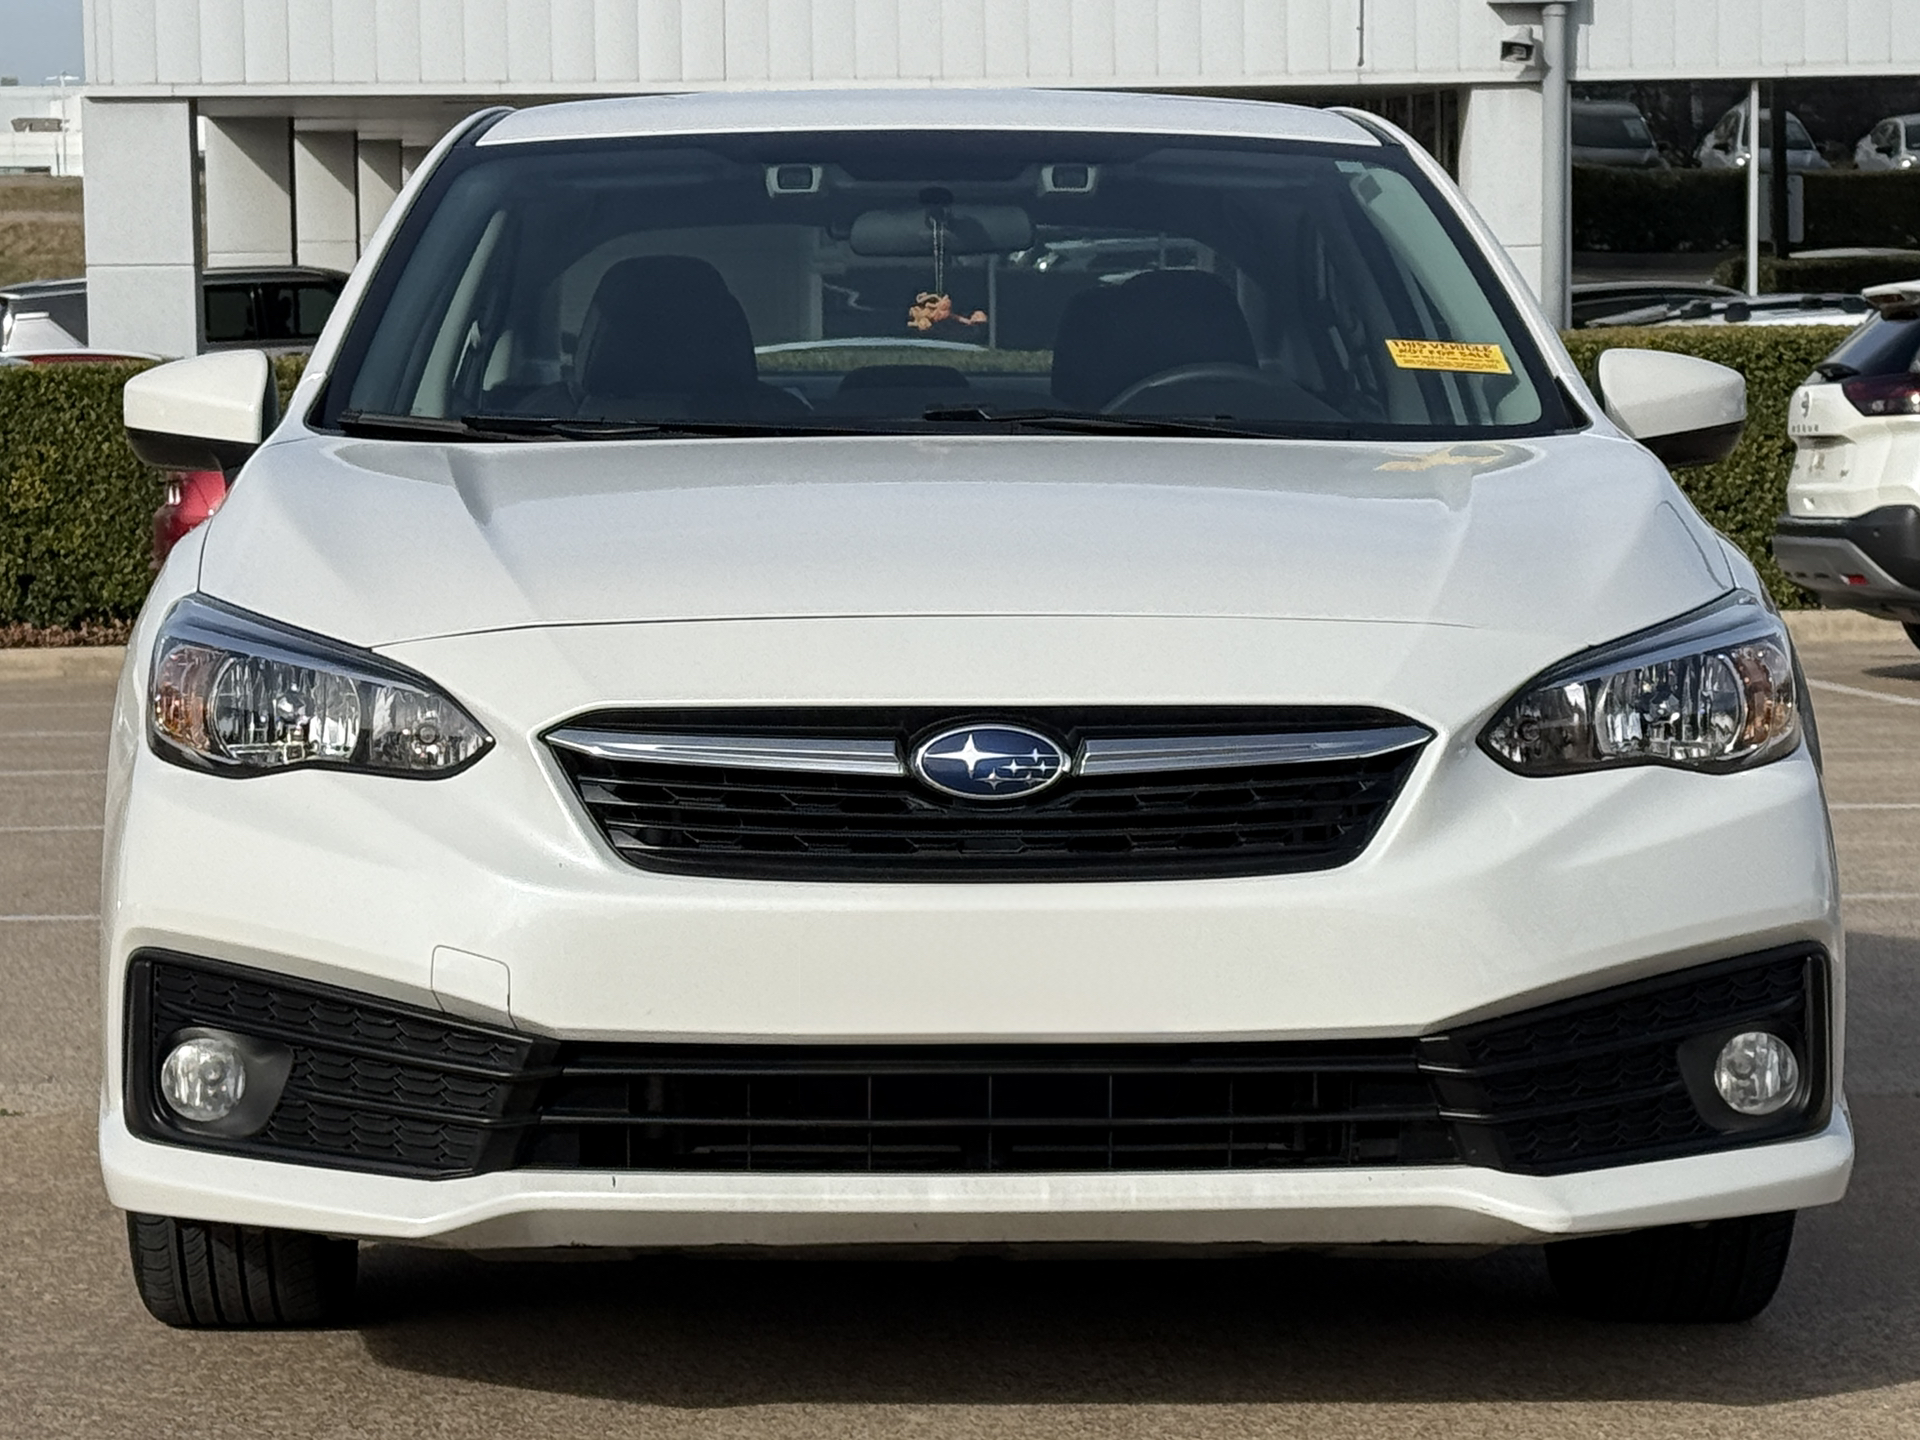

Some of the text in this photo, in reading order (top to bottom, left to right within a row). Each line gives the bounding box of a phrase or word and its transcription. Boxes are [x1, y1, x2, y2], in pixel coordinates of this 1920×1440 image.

[1392, 341, 1493, 353] THIS VEHICLE
[1458, 351, 1492, 359] SALE
